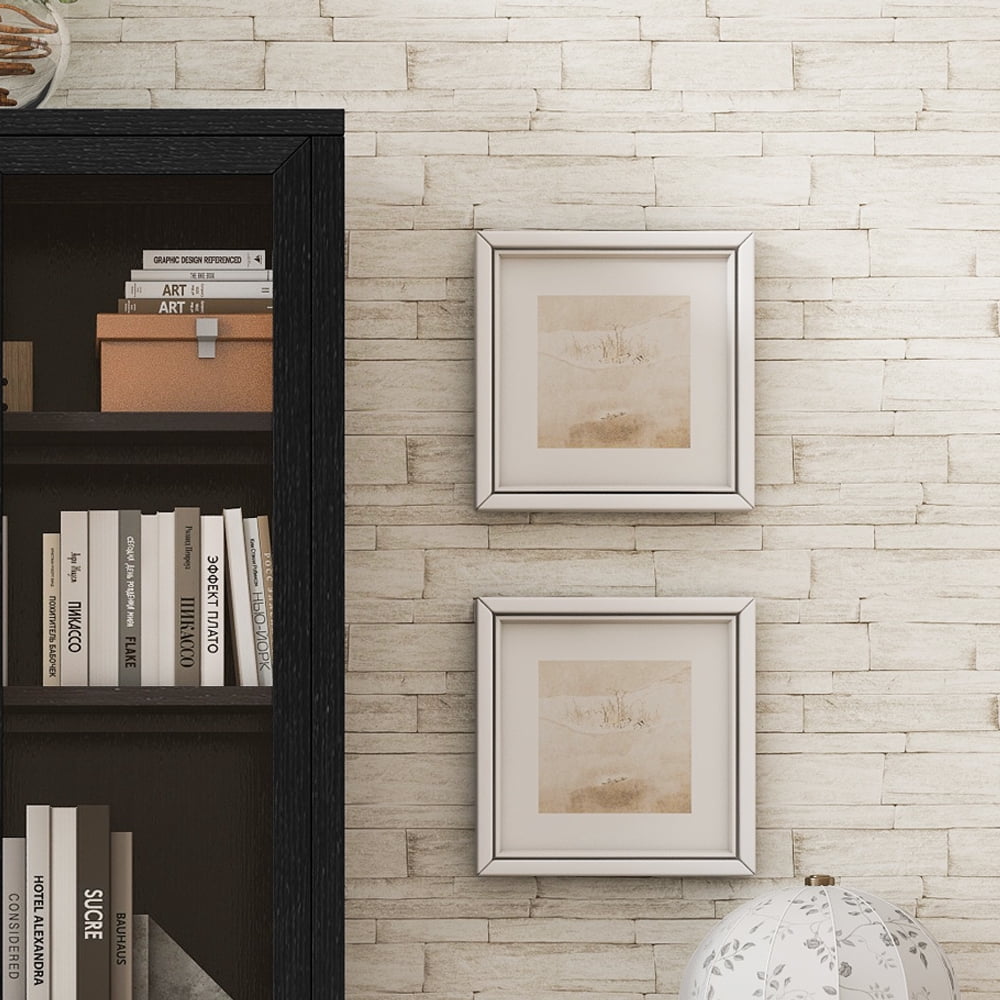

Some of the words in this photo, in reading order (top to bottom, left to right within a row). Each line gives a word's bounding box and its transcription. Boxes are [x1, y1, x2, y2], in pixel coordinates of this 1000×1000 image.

[153, 256, 180, 264] GRAPHIC
[181, 256, 203, 264] DESIGN
[204, 256, 242, 264] REFERENCED
[158, 301, 186, 314] ART
[162, 284, 187, 296] ART
[207, 555, 219, 607] ЭФФЕКТ
[264, 552, 273, 582] РОСС
[48, 596, 57, 643] ПОХИТИТЕЛЬ
[68, 601, 82, 653] ПИКАССО
[180, 597, 195, 668] ПИКАССО
[207, 610, 219, 654] ПЛАТО
[48, 644, 57, 678] БАБОЧЕК
[124, 636, 136, 668] FLAKE
[33, 875, 44, 912] HOTEL
[84, 889, 104, 940] SUCRE
[8, 893, 20, 980] CONSIDERED
[33, 916, 44, 986] ALEXANDRA
[116, 912, 126, 966] BAUHAUS
